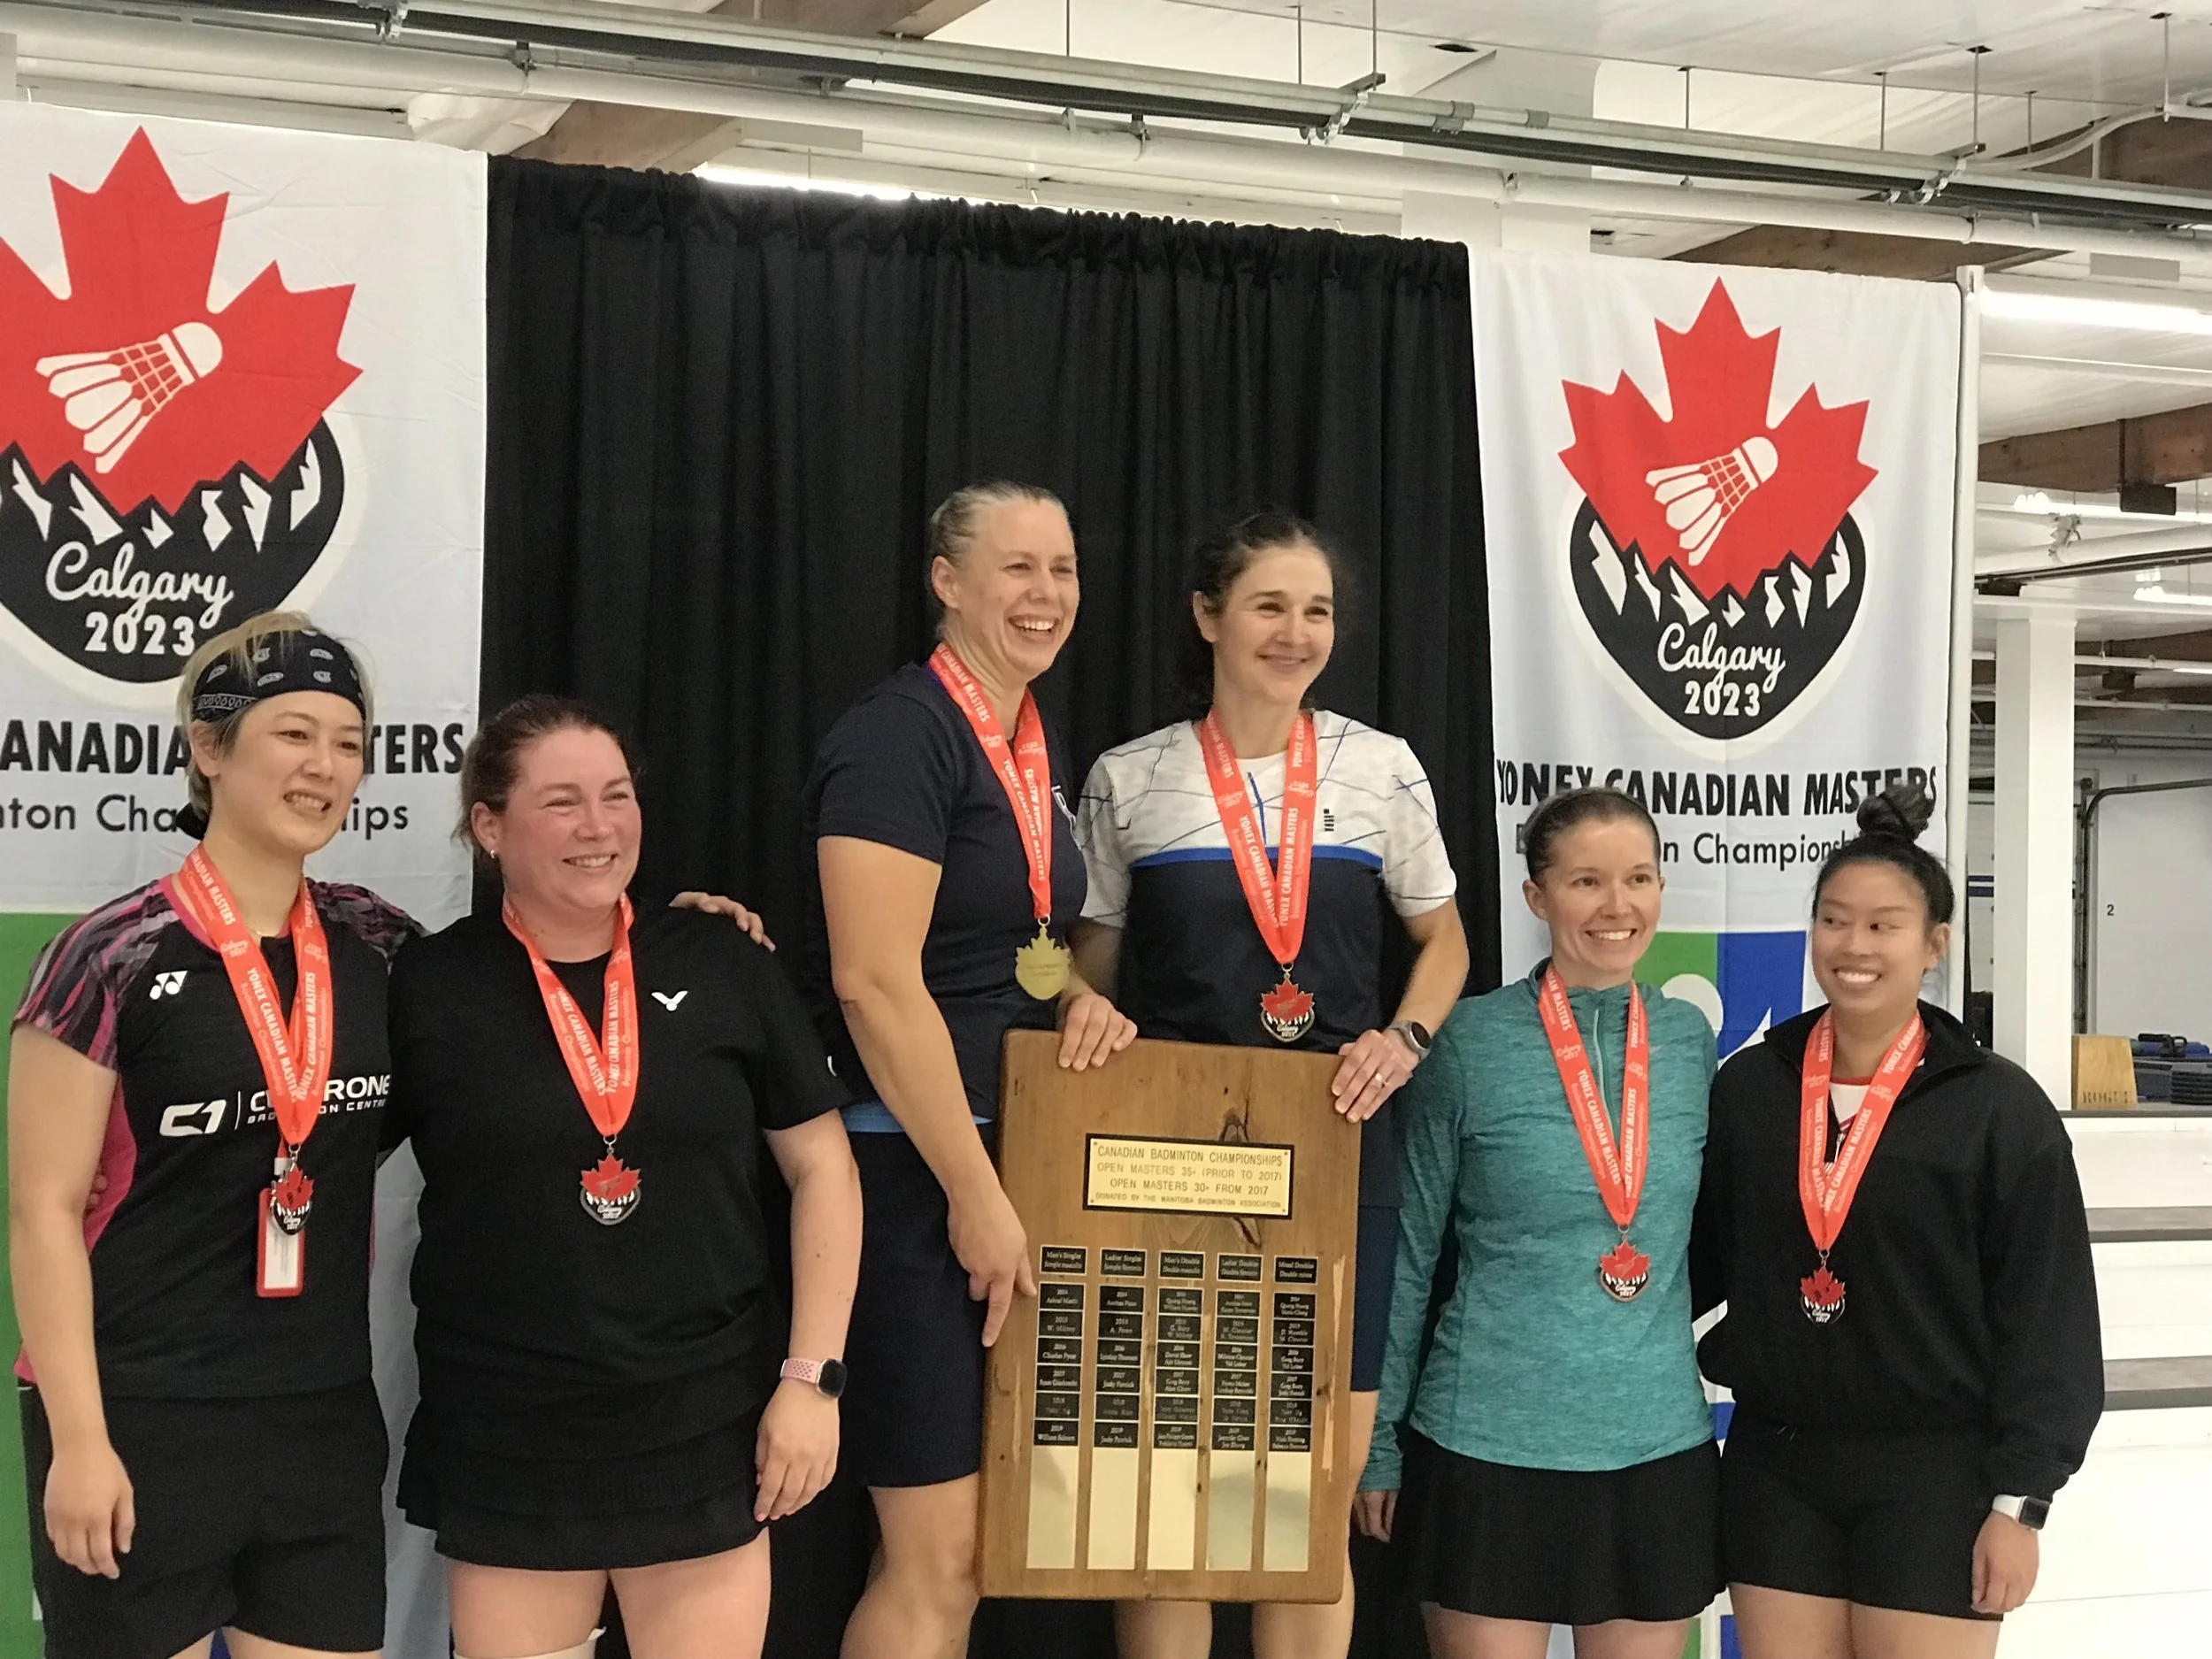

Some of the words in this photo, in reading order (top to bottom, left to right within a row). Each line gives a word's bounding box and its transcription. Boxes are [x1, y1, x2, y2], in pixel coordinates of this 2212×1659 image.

[45, 541, 234, 629] Calgary
[85, 611, 196, 657] 2023
[1657, 622, 1786, 694] Calgary
[1684, 681, 1760, 717] 2023
[0, 719, 191, 775] ANADIA
[364, 723, 465, 774] TERS
[1286, 807, 1298, 846] MASTERS
[1281, 848, 1295, 895] CANADIAN
[208, 885, 236, 926] MASTERS
[2106, 904, 2115, 917] 2
[247, 967, 268, 1002] YONEX
[260, 1002, 288, 1056] CANADIAN
[304, 972, 316, 1014] MASTERS
[1552, 992, 1572, 1032] MASTERS
[567, 1013, 593, 1056] CANADIAN
[587, 1055, 607, 1096] MASTERS
[608, 1019, 619, 1065] CANADIAN
[159, 1099, 227, 1137] C1
[250, 1074, 390, 1112] CRONE
[247, 1104, 339, 1125] BADON
[1626, 1087, 1637, 1126] MASTERS
[1578, 1069, 1594, 1099] YONEX
[1587, 1098, 1609, 1148] CANADIAN
[1602, 1146, 1622, 1186] MASTERS
[1097, 1145, 1145, 1158] CANADIAN
[1150, 1148, 1204, 1162] BADMINTON
[1209, 1151, 1283, 1167] CHAMPIONSHIPS
[1097, 1162, 1124, 1173] OPEN
[1131, 1164, 1175, 1177] MASTERS
[1241, 1170, 1253, 1179] TO
[1095, 1192, 1127, 1201] DONATED
[1197, 1197, 1236, 1206] BADMINTON
[1240, 1199, 1281, 1209] ASSOCIATION
[1110, 1178, 1136, 1188] OPEN
[1143, 1180, 1188, 1192] MASTERS
[1216, 1184, 1241, 1194] FROM
[1248, 1186, 1268, 1195] 2017
